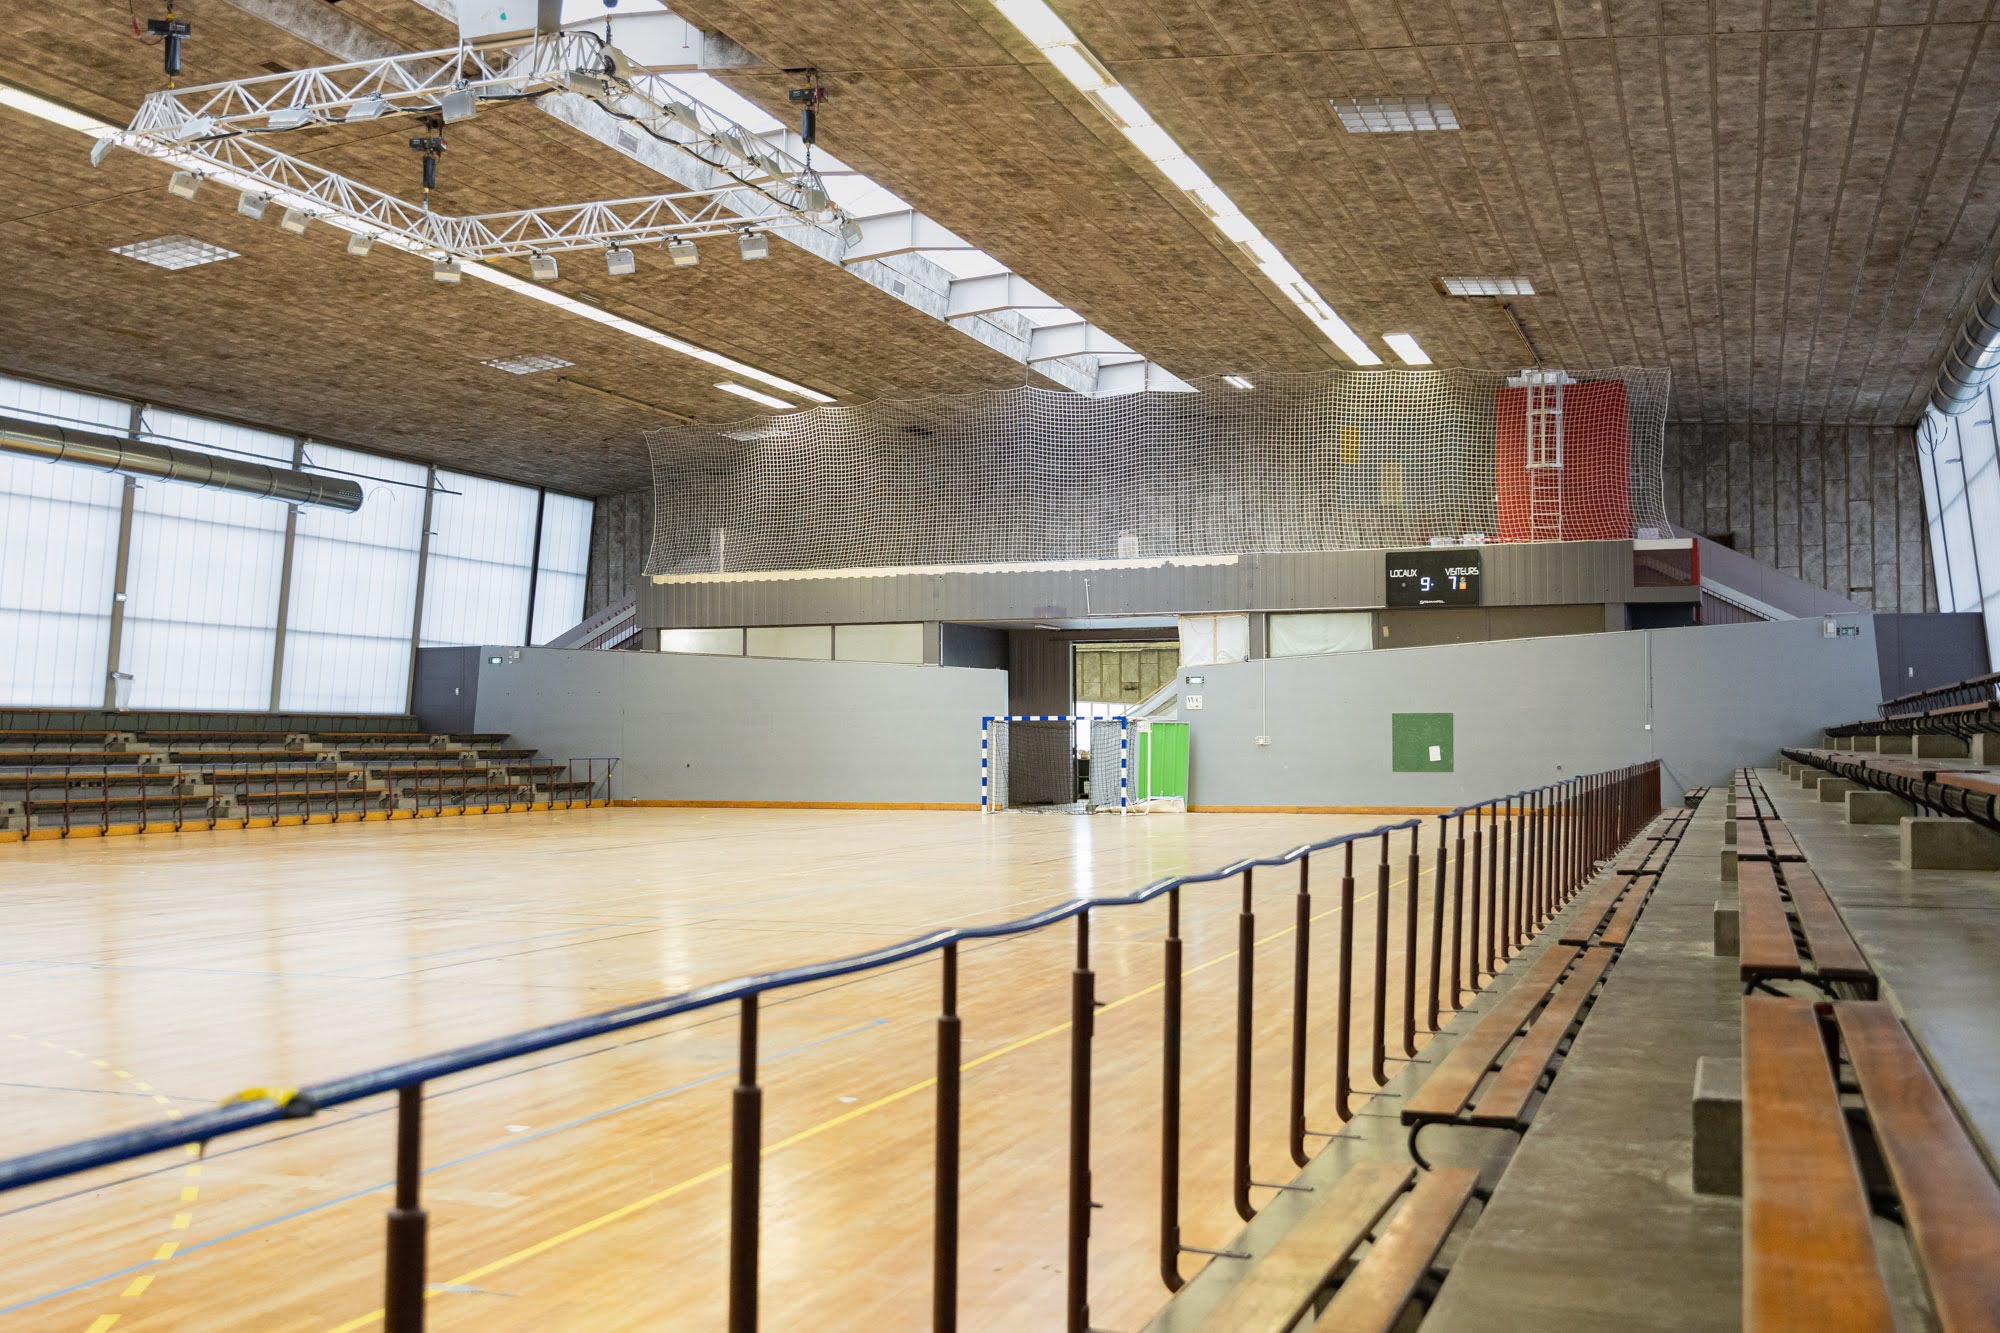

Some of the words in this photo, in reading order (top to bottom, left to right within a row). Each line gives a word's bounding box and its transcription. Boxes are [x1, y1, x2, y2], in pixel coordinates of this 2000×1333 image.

[1390, 569, 1417, 577] LOCAUX
[1445, 567, 1479, 576] VISITEURS
[1420, 576, 1431, 591] 9
[1448, 576, 1457, 590] 7
